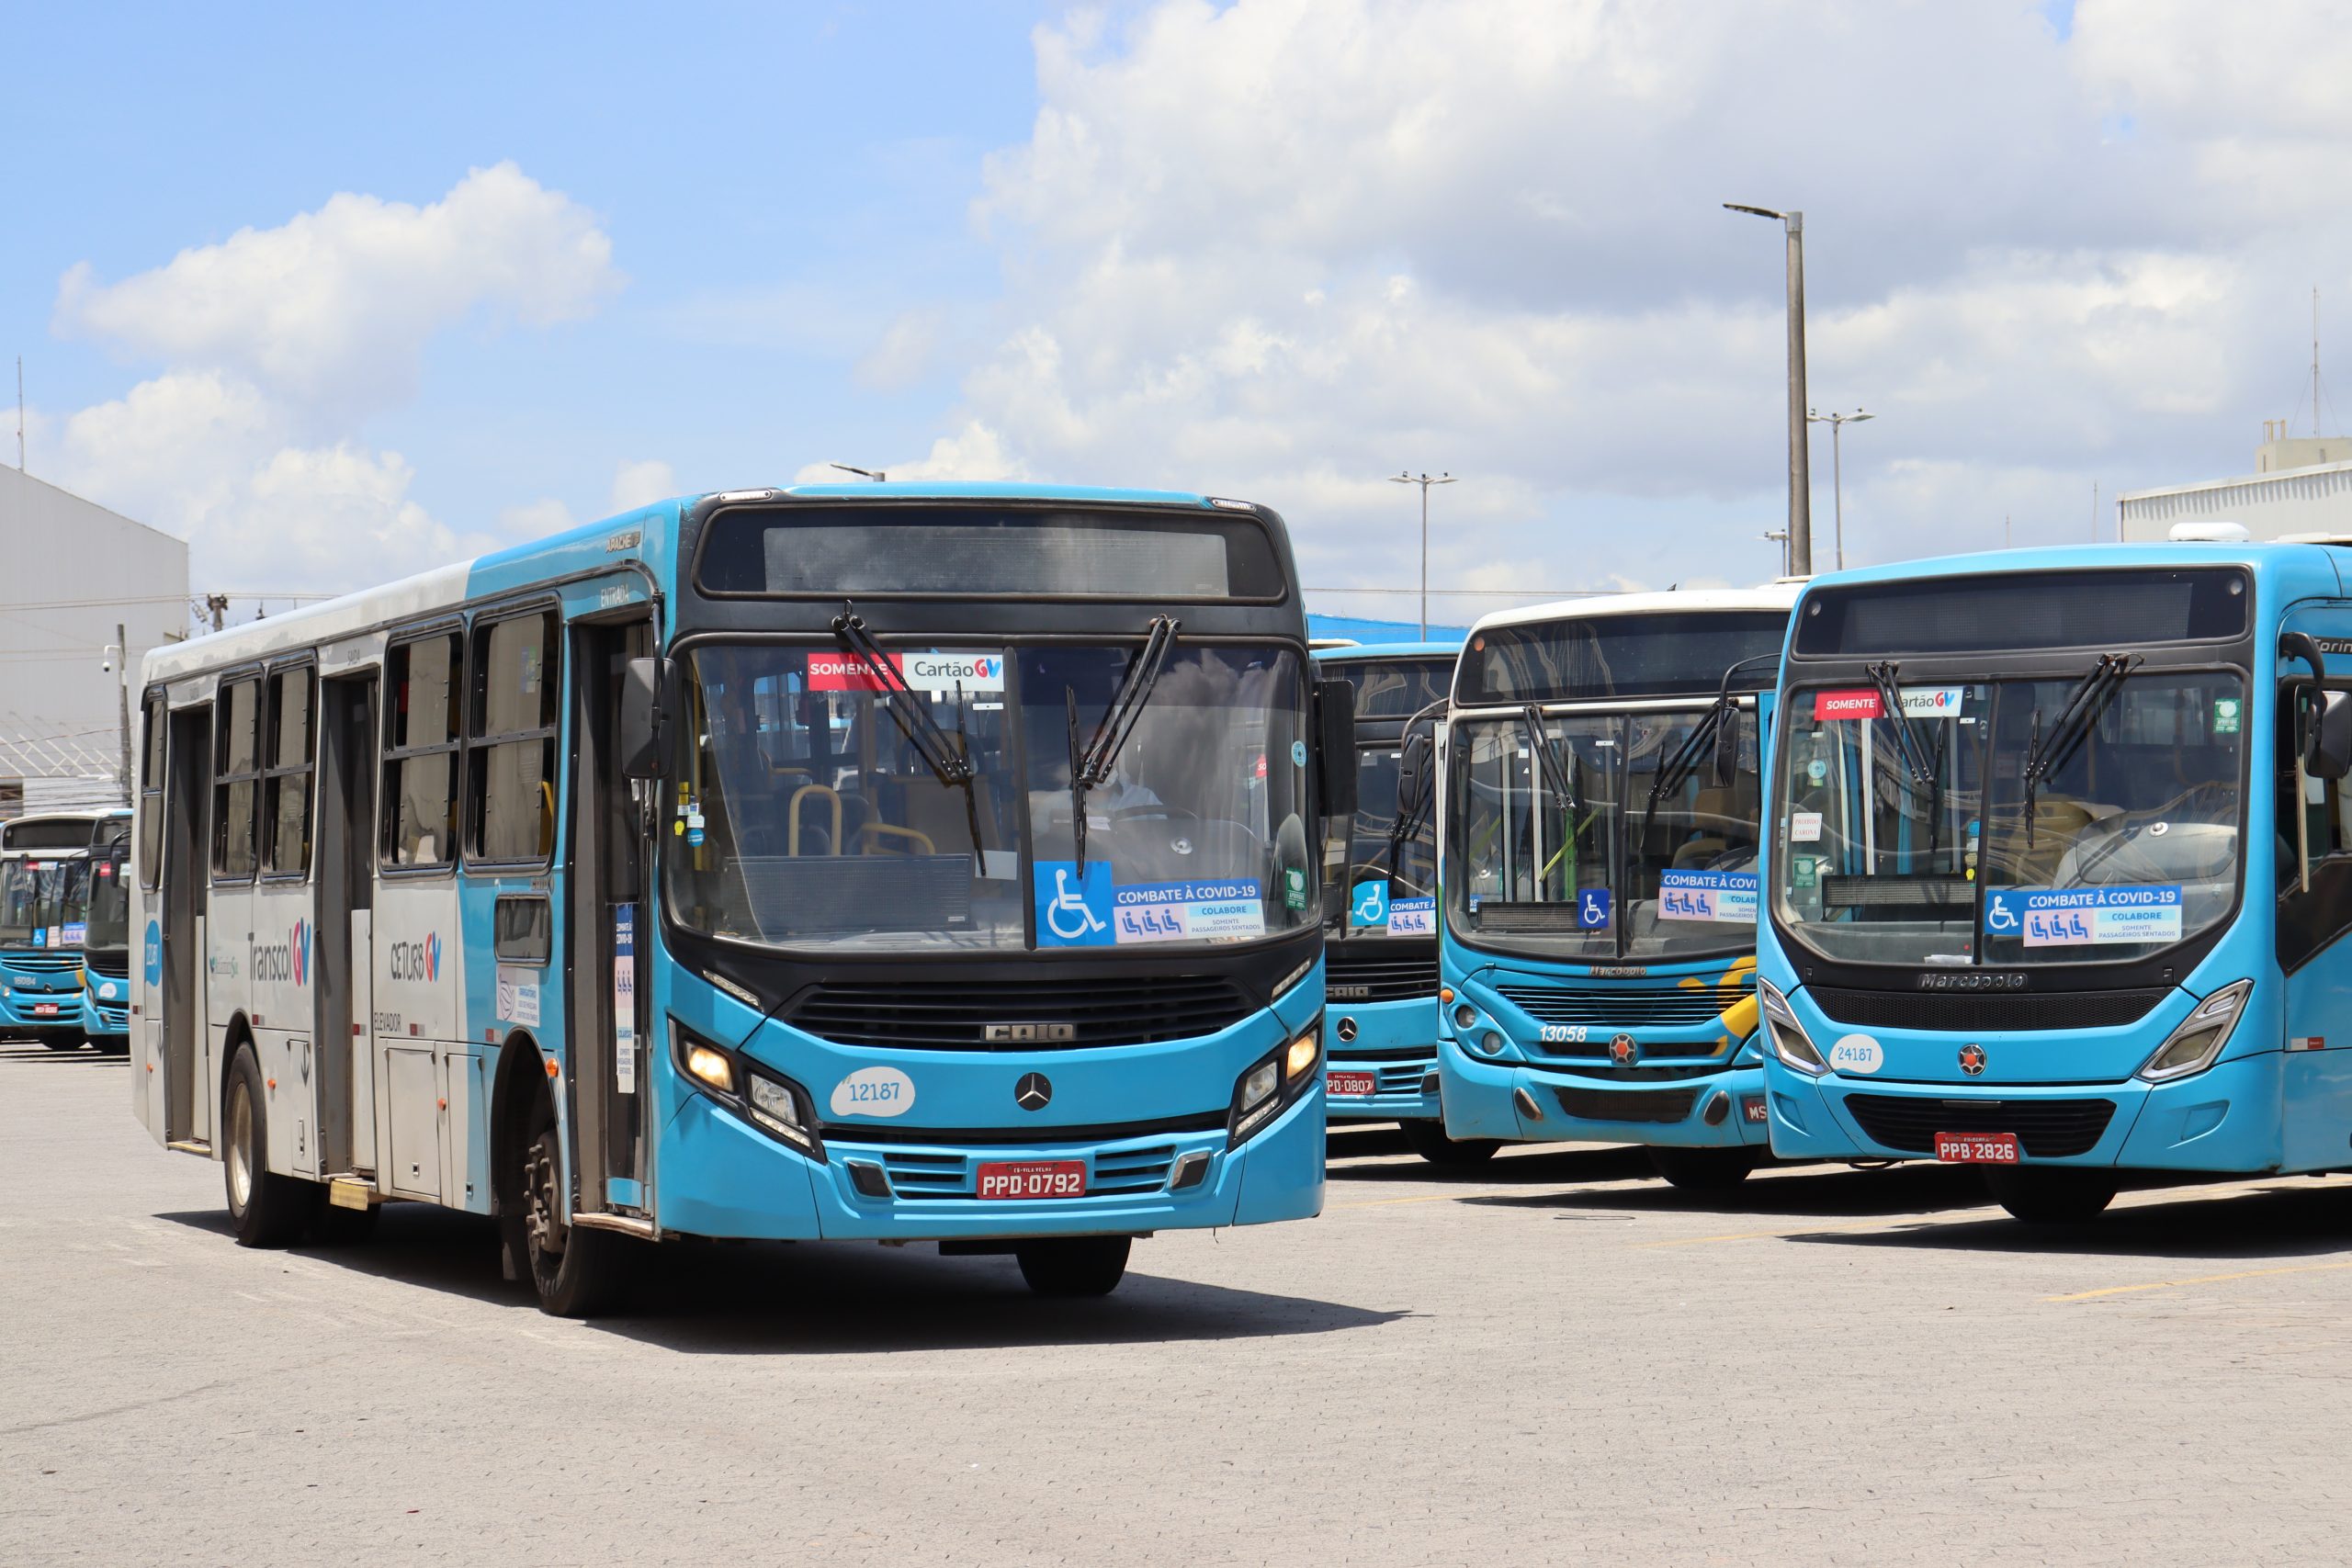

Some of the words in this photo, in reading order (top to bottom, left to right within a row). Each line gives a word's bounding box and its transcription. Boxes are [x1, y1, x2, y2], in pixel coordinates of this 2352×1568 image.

[601, 583, 629, 607] ENTRADA
[1826, 698, 1876, 710] SOMENTE
[1665, 874, 1718, 887] COMBATE
[1719, 874, 1730, 887] À
[1730, 877, 1757, 888] COVI
[1117, 888, 1182, 904] COMBATE
[1185, 885, 1194, 900] À
[1196, 886, 1256, 899] COVID-19
[2029, 893, 2093, 908] COMBATE
[2097, 890, 2108, 905] À
[2109, 890, 2176, 905] COVID-19
[1202, 906, 1247, 915] COLABORE
[1390, 902, 1430, 911] COMBATE
[2111, 912, 2162, 920] COLABORE
[1192, 925, 1231, 933] PASSAGEIROS
[1590, 965, 1647, 976] Marcopolo
[1921, 974, 2023, 989] Marcopolo
[374, 1012, 401, 1032] ELEVADOR
[986, 1024, 1073, 1041] CAIO
[1540, 1025, 1588, 1042] 13058
[1838, 1046, 1872, 1061] 24187
[850, 1082, 900, 1102] 12187
